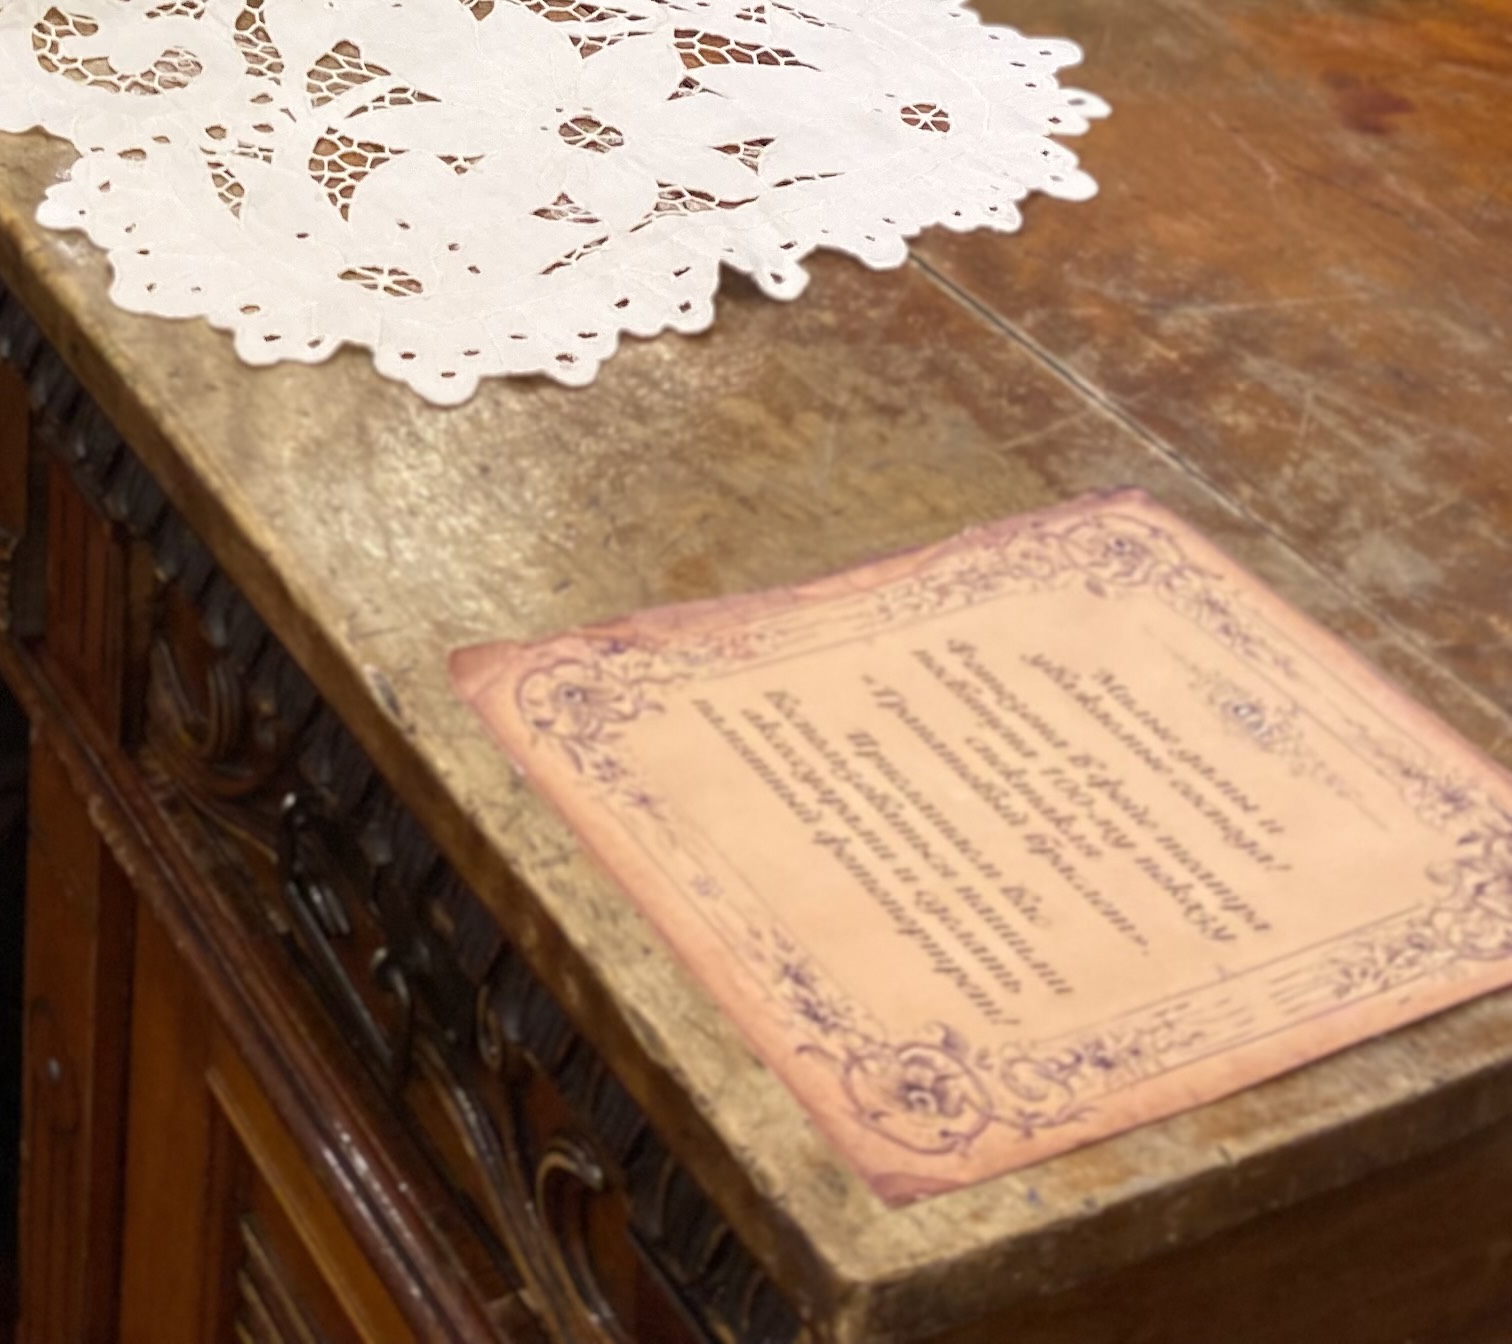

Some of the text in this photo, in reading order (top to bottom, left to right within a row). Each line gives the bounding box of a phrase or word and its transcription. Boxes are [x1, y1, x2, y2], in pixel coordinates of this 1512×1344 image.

[691, 697, 1022, 1027] памятный фотопортрет!
[739, 707, 1023, 996] аксессуарами и сделать
[762, 689, 1075, 997] воспользоваться нашими
[844, 729, 1004, 881] Приглашаем
[911, 648, 1041, 761] посвящена
[1133, 855, 1239, 944] показу
[963, 735, 1104, 860] спектакля
[1019, 652, 1293, 873] уважаемые господа!
[1084, 771, 1159, 831] фойе
[1153, 833, 1273, 934] театра
[1091, 671, 1286, 837] Милые дамы и
